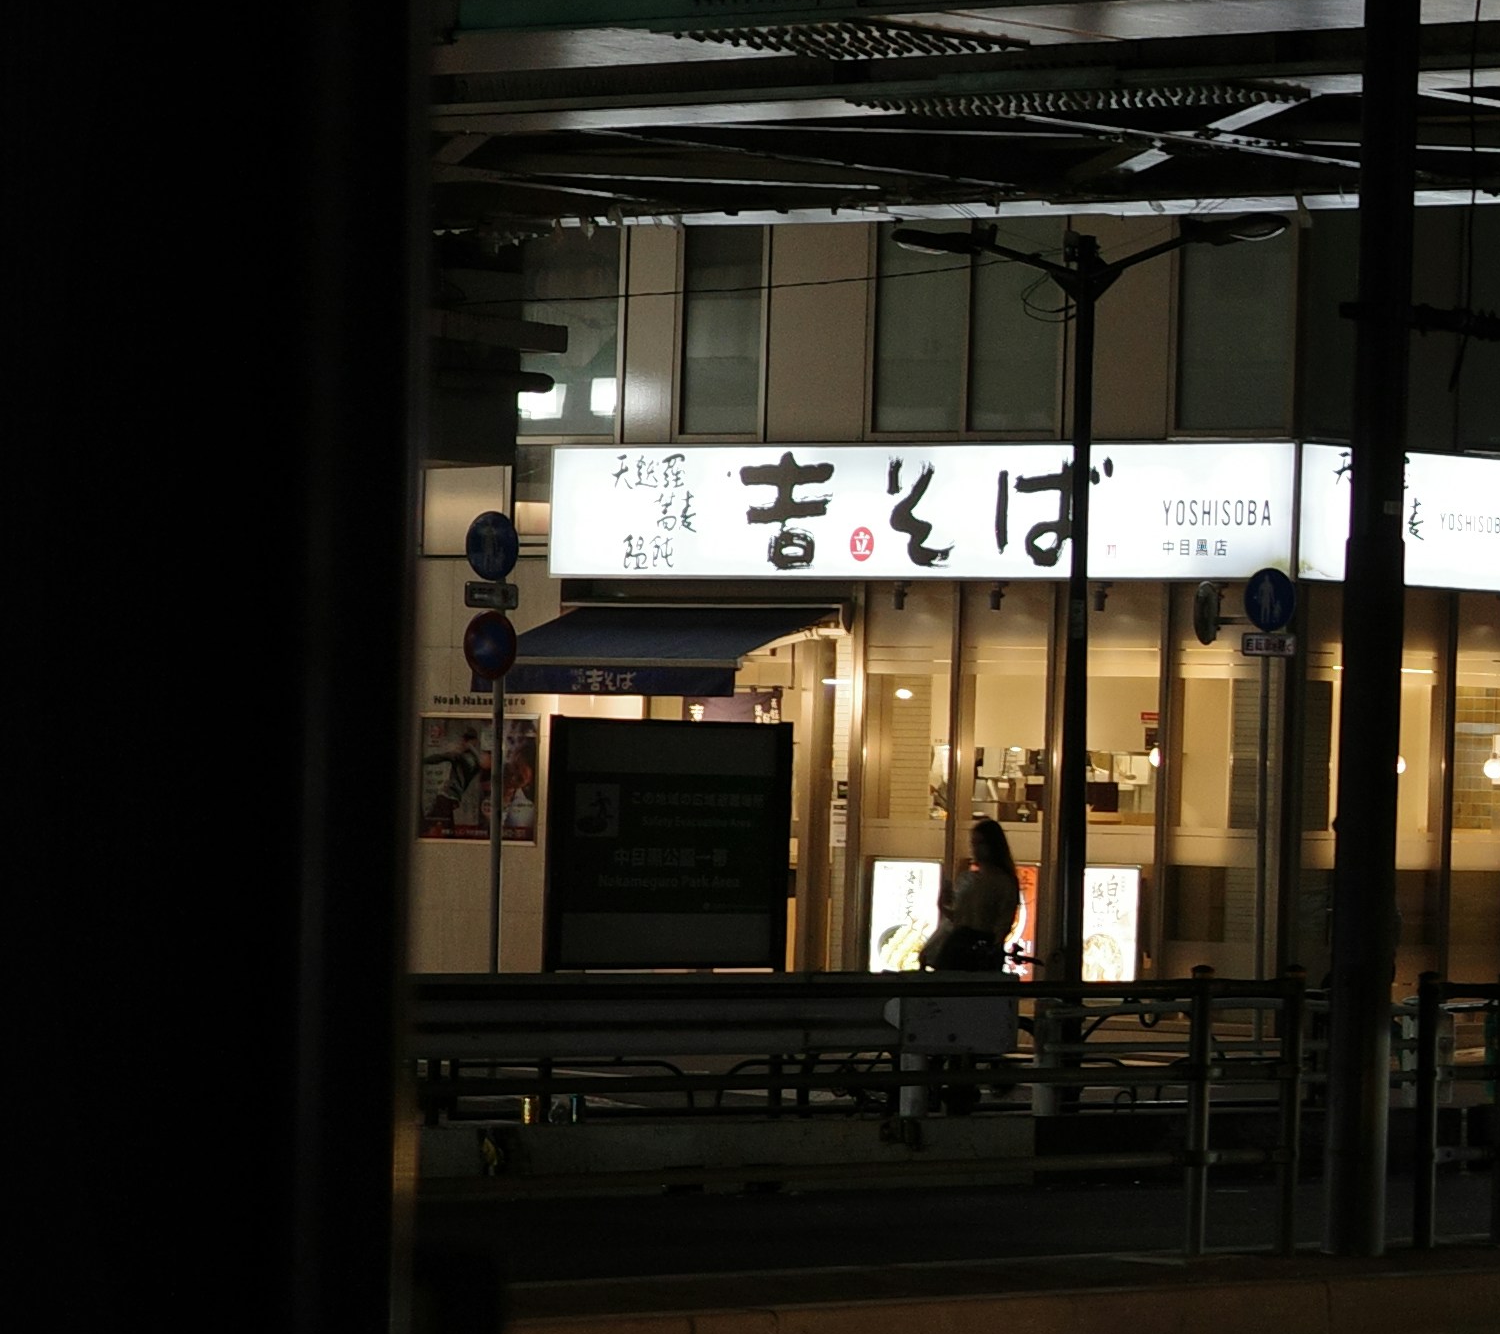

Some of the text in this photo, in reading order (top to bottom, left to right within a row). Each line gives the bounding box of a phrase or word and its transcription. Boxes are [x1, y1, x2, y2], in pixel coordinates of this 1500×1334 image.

[739, 451, 1114, 571] 吉そば
[1162, 499, 1273, 528] YOSHISOBA
[1162, 539, 1228, 557] 中目黒店
[585, 670, 637, 691] 吉そば
[434, 695, 461, 706] Noah
[599, 875, 741, 891] Nakameguro Park Area
